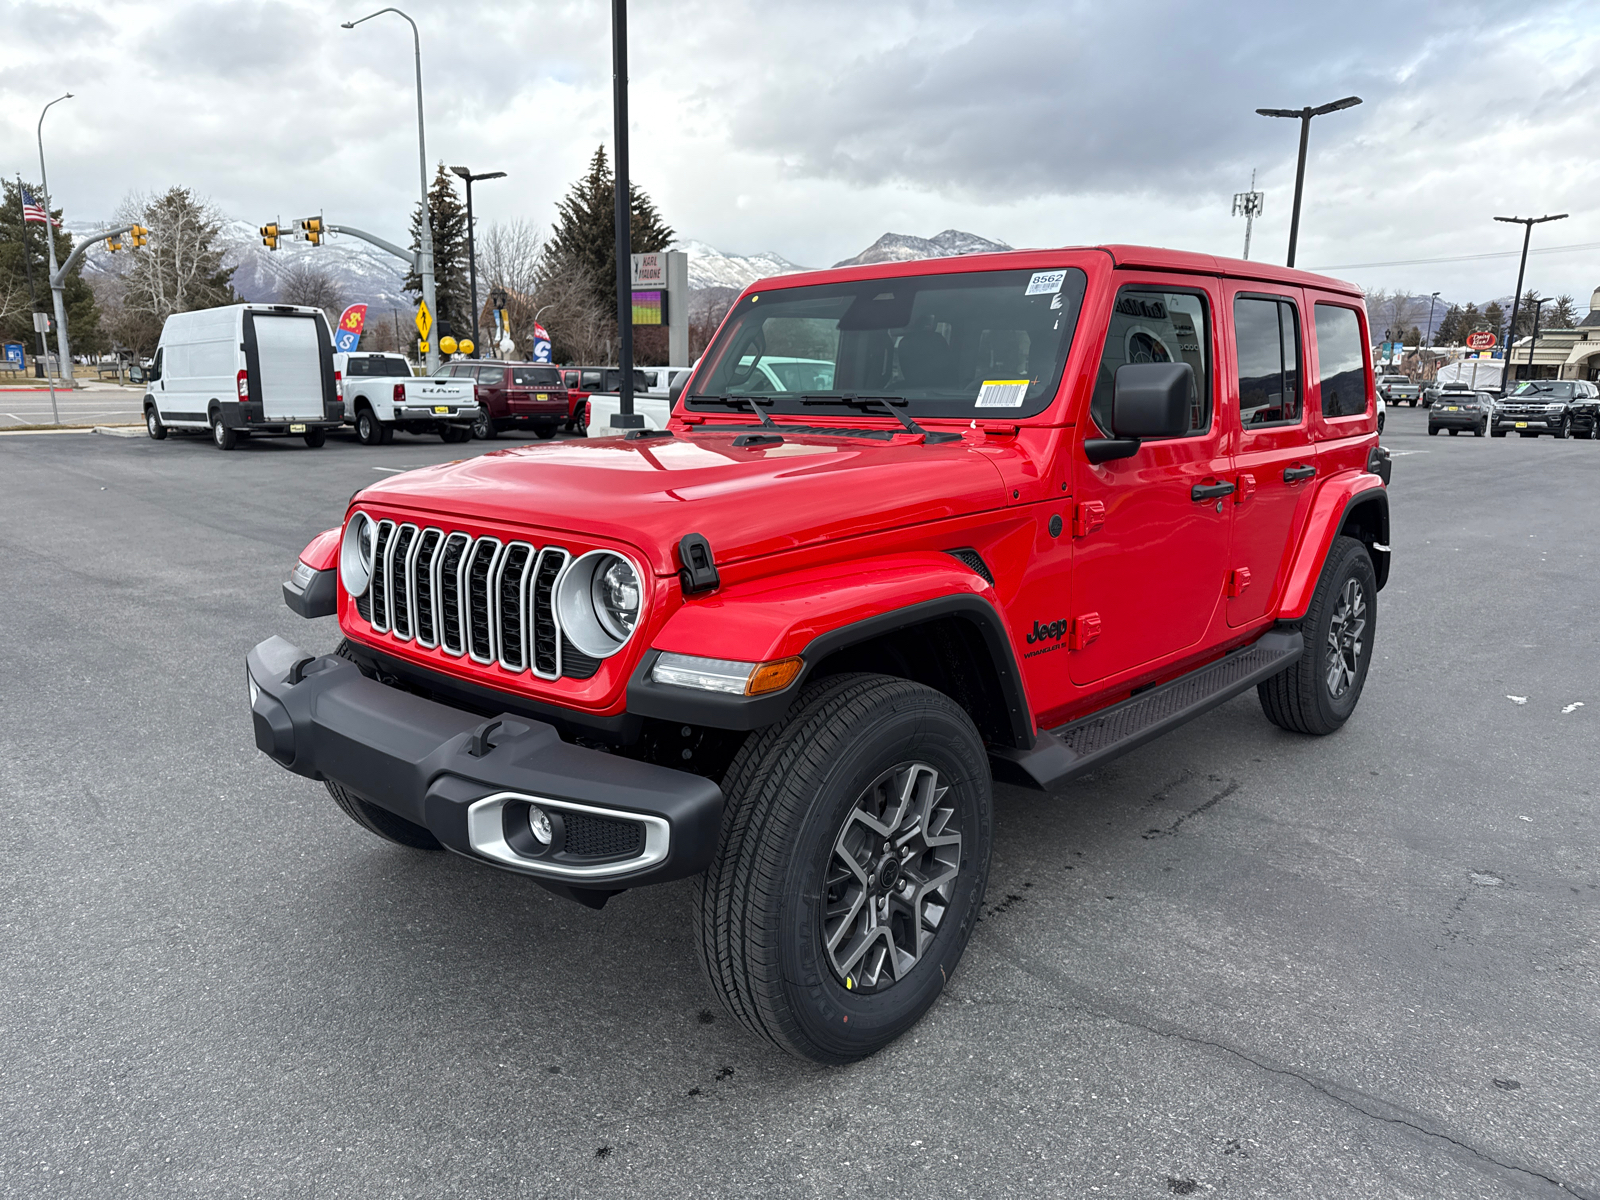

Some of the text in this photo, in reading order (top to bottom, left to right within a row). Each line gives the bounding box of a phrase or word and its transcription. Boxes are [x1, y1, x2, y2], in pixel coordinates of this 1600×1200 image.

[643, 255, 657, 267] KARL
[638, 268, 661, 279] MALONE
[1032, 273, 1064, 284] 8562
[1026, 618, 1068, 645] Jeep
[1023, 643, 1061, 659] WRANGLER
